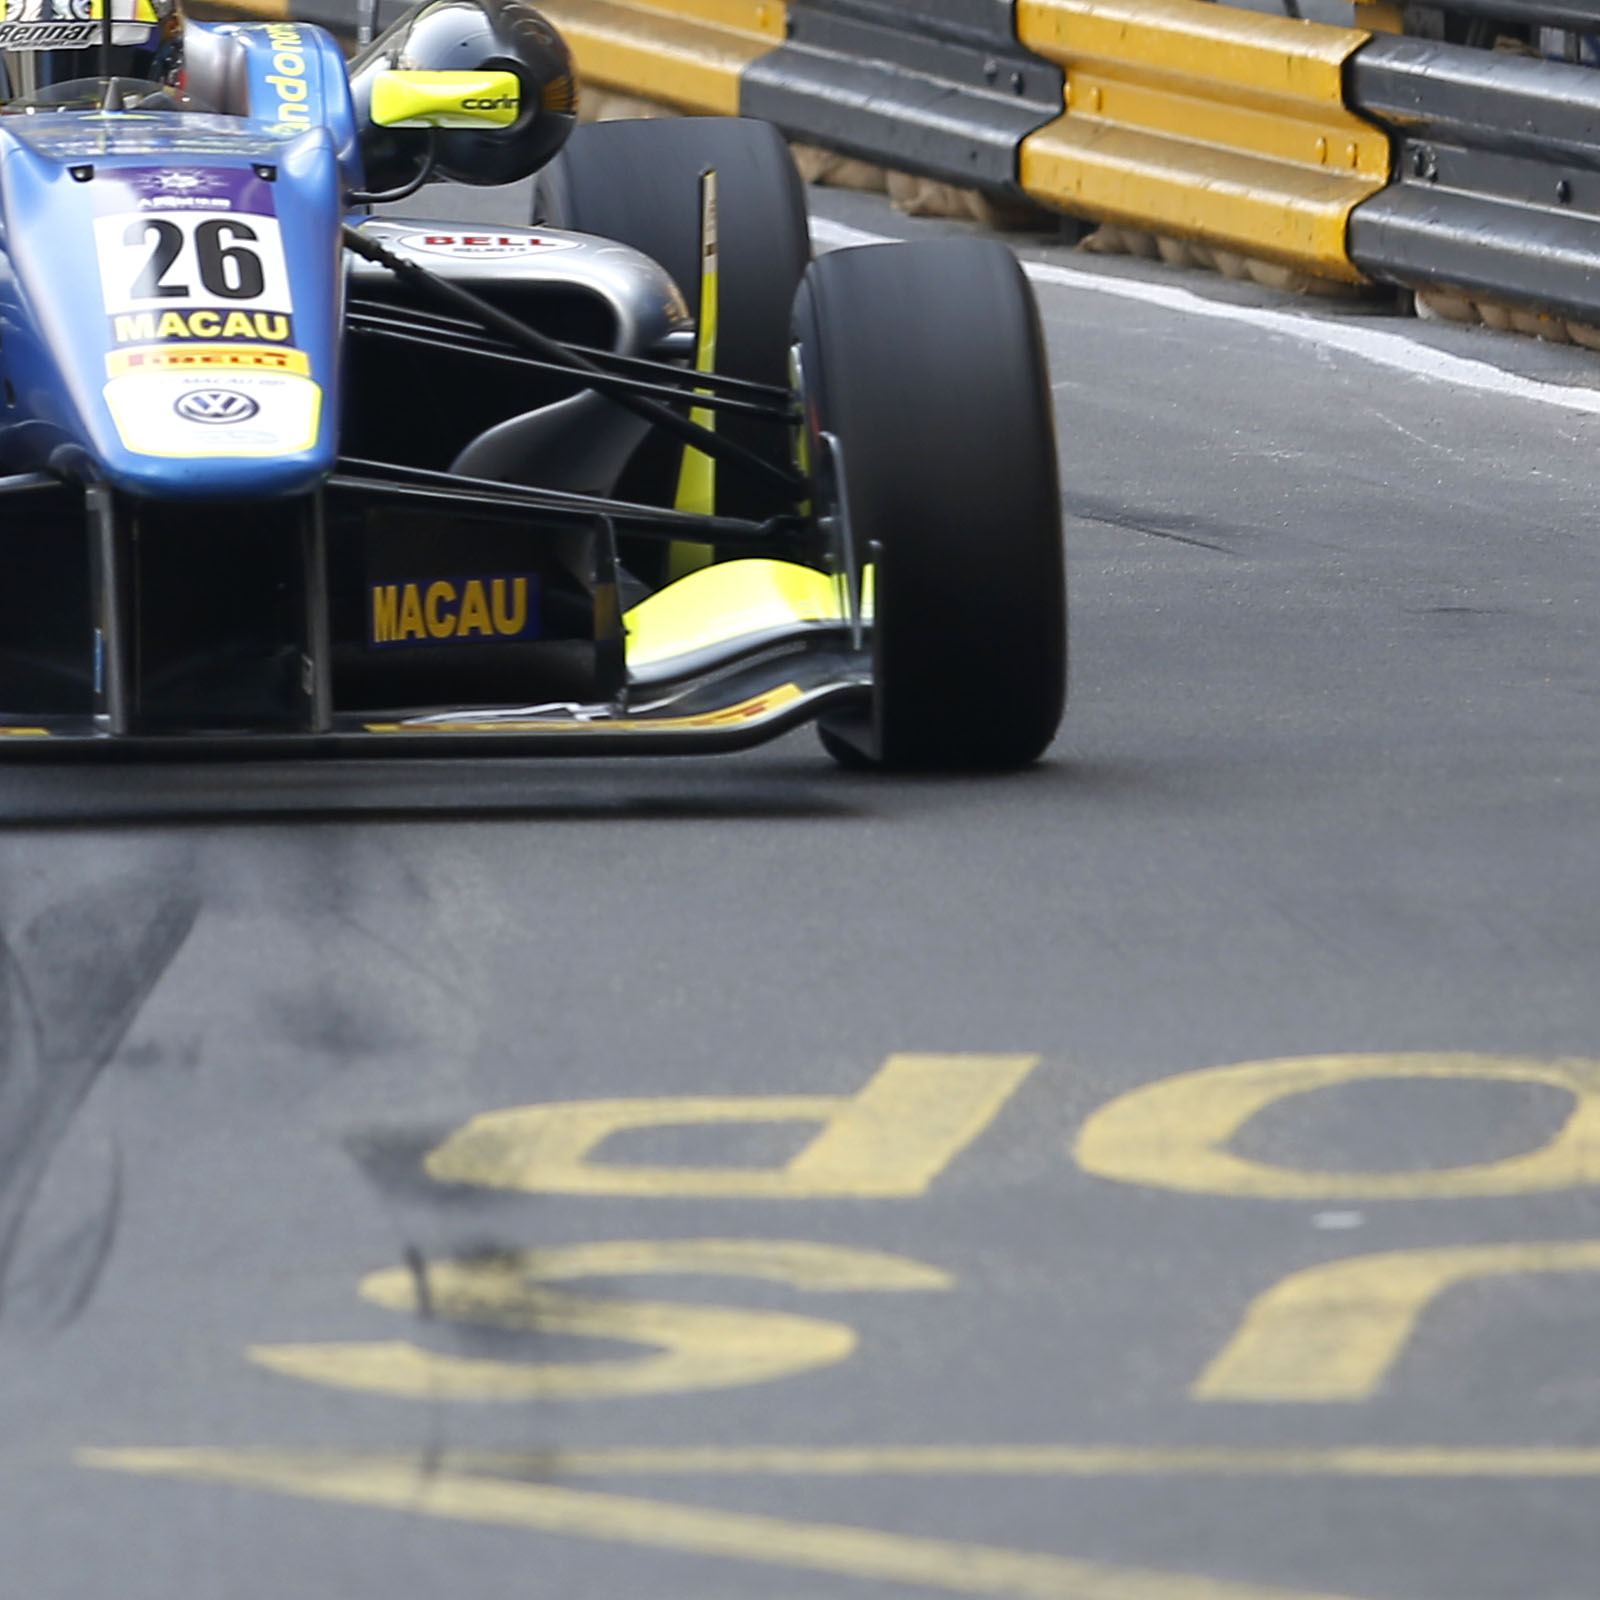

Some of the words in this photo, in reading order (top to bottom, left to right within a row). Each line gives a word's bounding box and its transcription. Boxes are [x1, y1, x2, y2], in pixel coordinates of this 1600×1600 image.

[122, 218, 266, 300] 26
[424, 236, 557, 247] BELL
[114, 311, 290, 342] MACAU
[373, 577, 528, 643] MACAU
